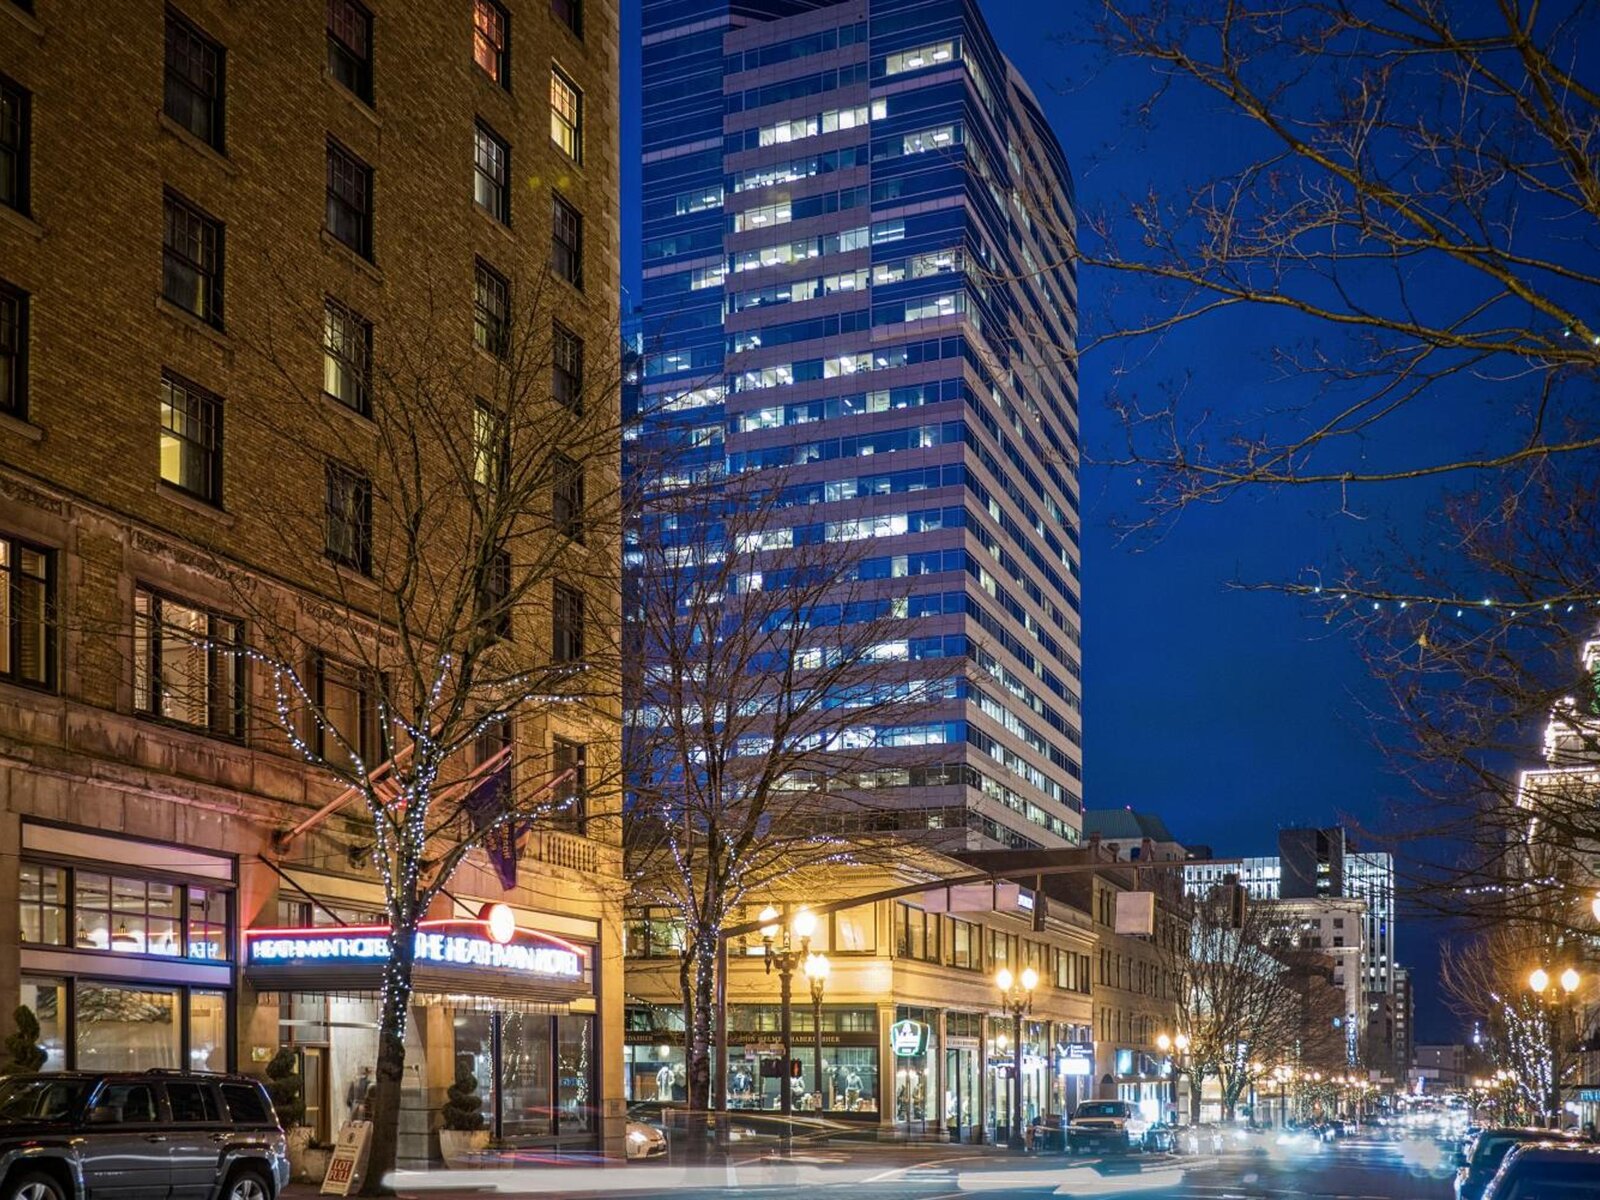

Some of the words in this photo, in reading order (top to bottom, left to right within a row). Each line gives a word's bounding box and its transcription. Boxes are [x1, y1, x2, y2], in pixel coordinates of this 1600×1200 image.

[252, 939, 340, 959] HEATHMAN
[341, 937, 391, 958] HOTEL
[447, 936, 536, 970] HEATHMAN
[536, 946, 582, 976] HOTEL
[333, 1160, 353, 1171] LOT
